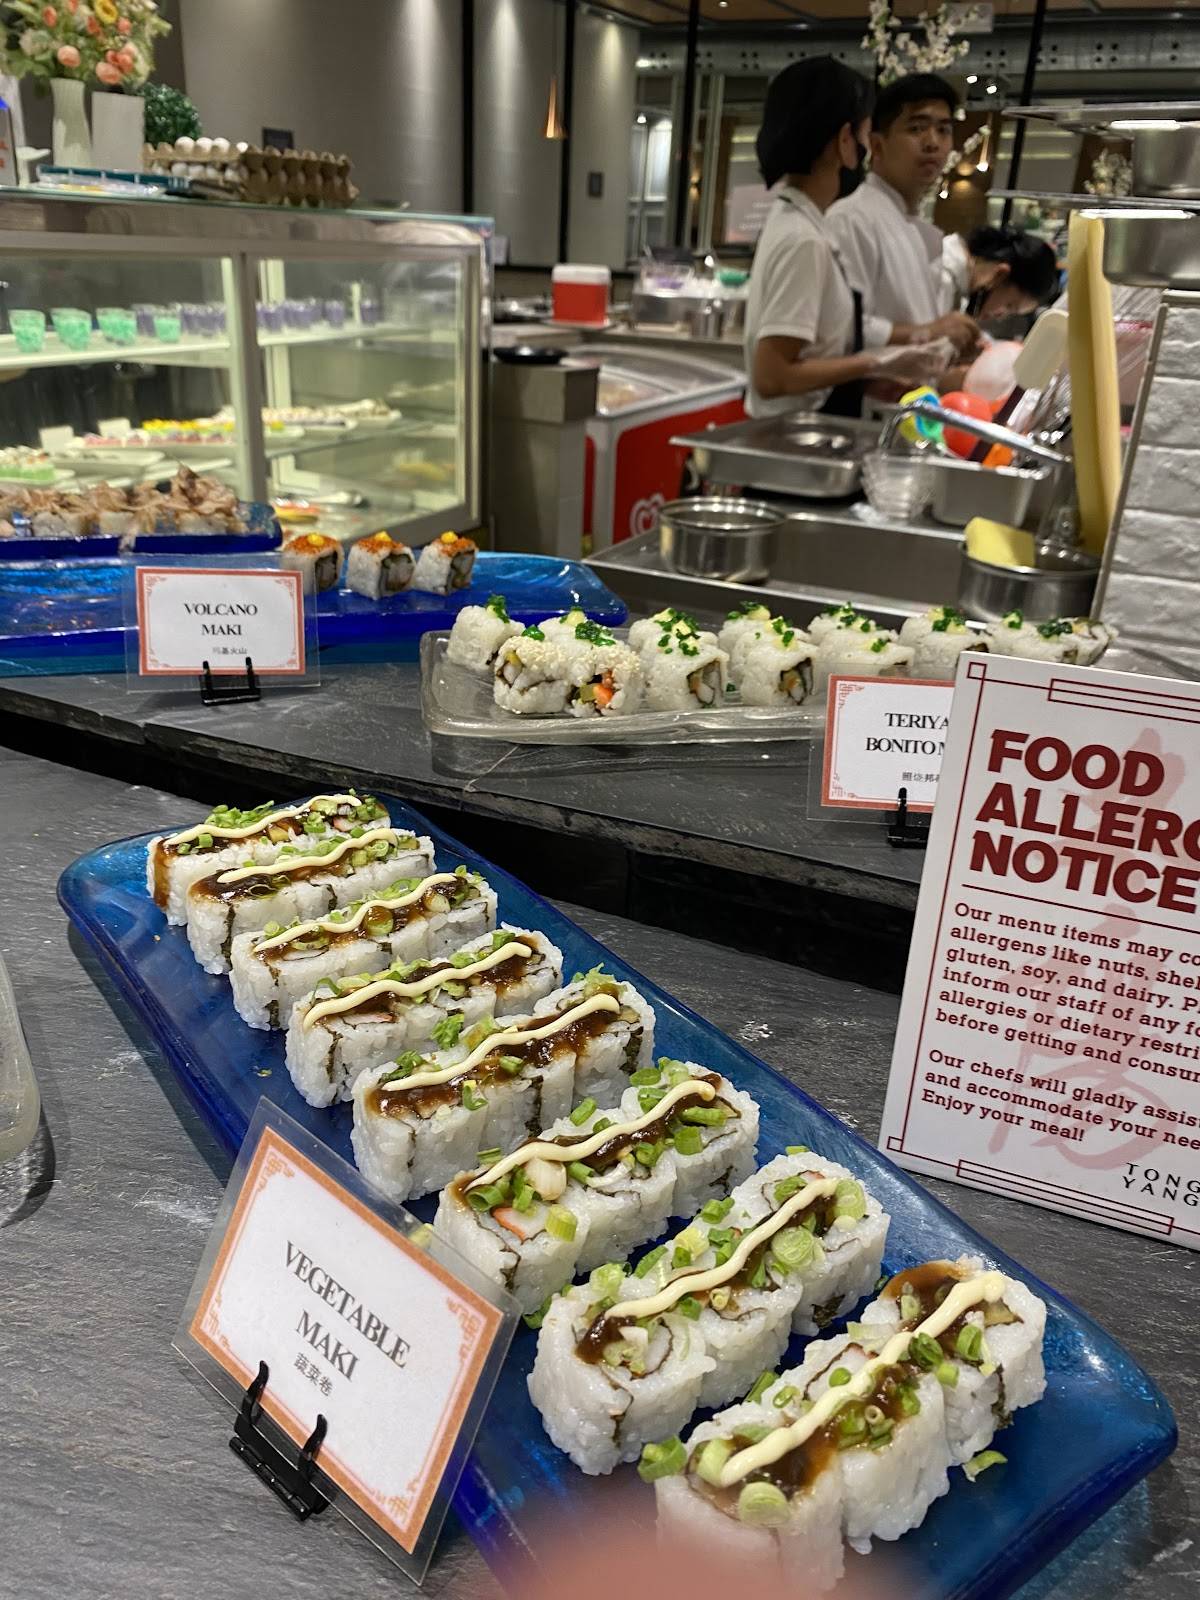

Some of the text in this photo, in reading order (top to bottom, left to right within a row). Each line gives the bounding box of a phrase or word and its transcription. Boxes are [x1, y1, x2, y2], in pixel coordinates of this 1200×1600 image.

[184, 603, 258, 617] VOLCANO
[202, 624, 242, 636] MAKI
[866, 737, 936, 755] BONITO
[987, 729, 1165, 797] FOOD
[970, 830, 1200, 914] NOTICE
[950, 926, 1047, 956] allergens
[1051, 945, 1091, 965] like
[1097, 958, 1149, 981] nuts,
[954, 902, 992, 922] Our
[997, 914, 1057, 935] menu
[1061, 925, 1120, 949] items
[1126, 941, 1174, 962] may
[942, 967, 1010, 993] inform
[1016, 986, 1051, 1002] our
[1056, 994, 1107, 1015] staff
[1112, 1007, 1134, 1021] of
[1139, 1014, 1180, 1033] any
[946, 948, 1016, 974] gluten,
[1021, 965, 1061, 984] soy,
[1067, 975, 1106, 993] and
[1113, 983, 1174, 1008] dairy.
[935, 1008, 999, 1034] before
[1004, 1027, 1077, 1056] getting
[1082, 1046, 1122, 1064] and
[939, 990, 1200, 1060] allergies or dietary restri
[921, 1088, 1085, 1141] Enjoy your meal!
[925, 1072, 1200, 1150] and accommodate your nee
[929, 1049, 1200, 1128] Our chefs will gladly assis
[1122, 1176, 1199, 1207] YANG
[1126, 1163, 1200, 1193] TONG
[285, 1240, 411, 1369] VEGETABLE
[295, 1309, 359, 1382] MAKI
